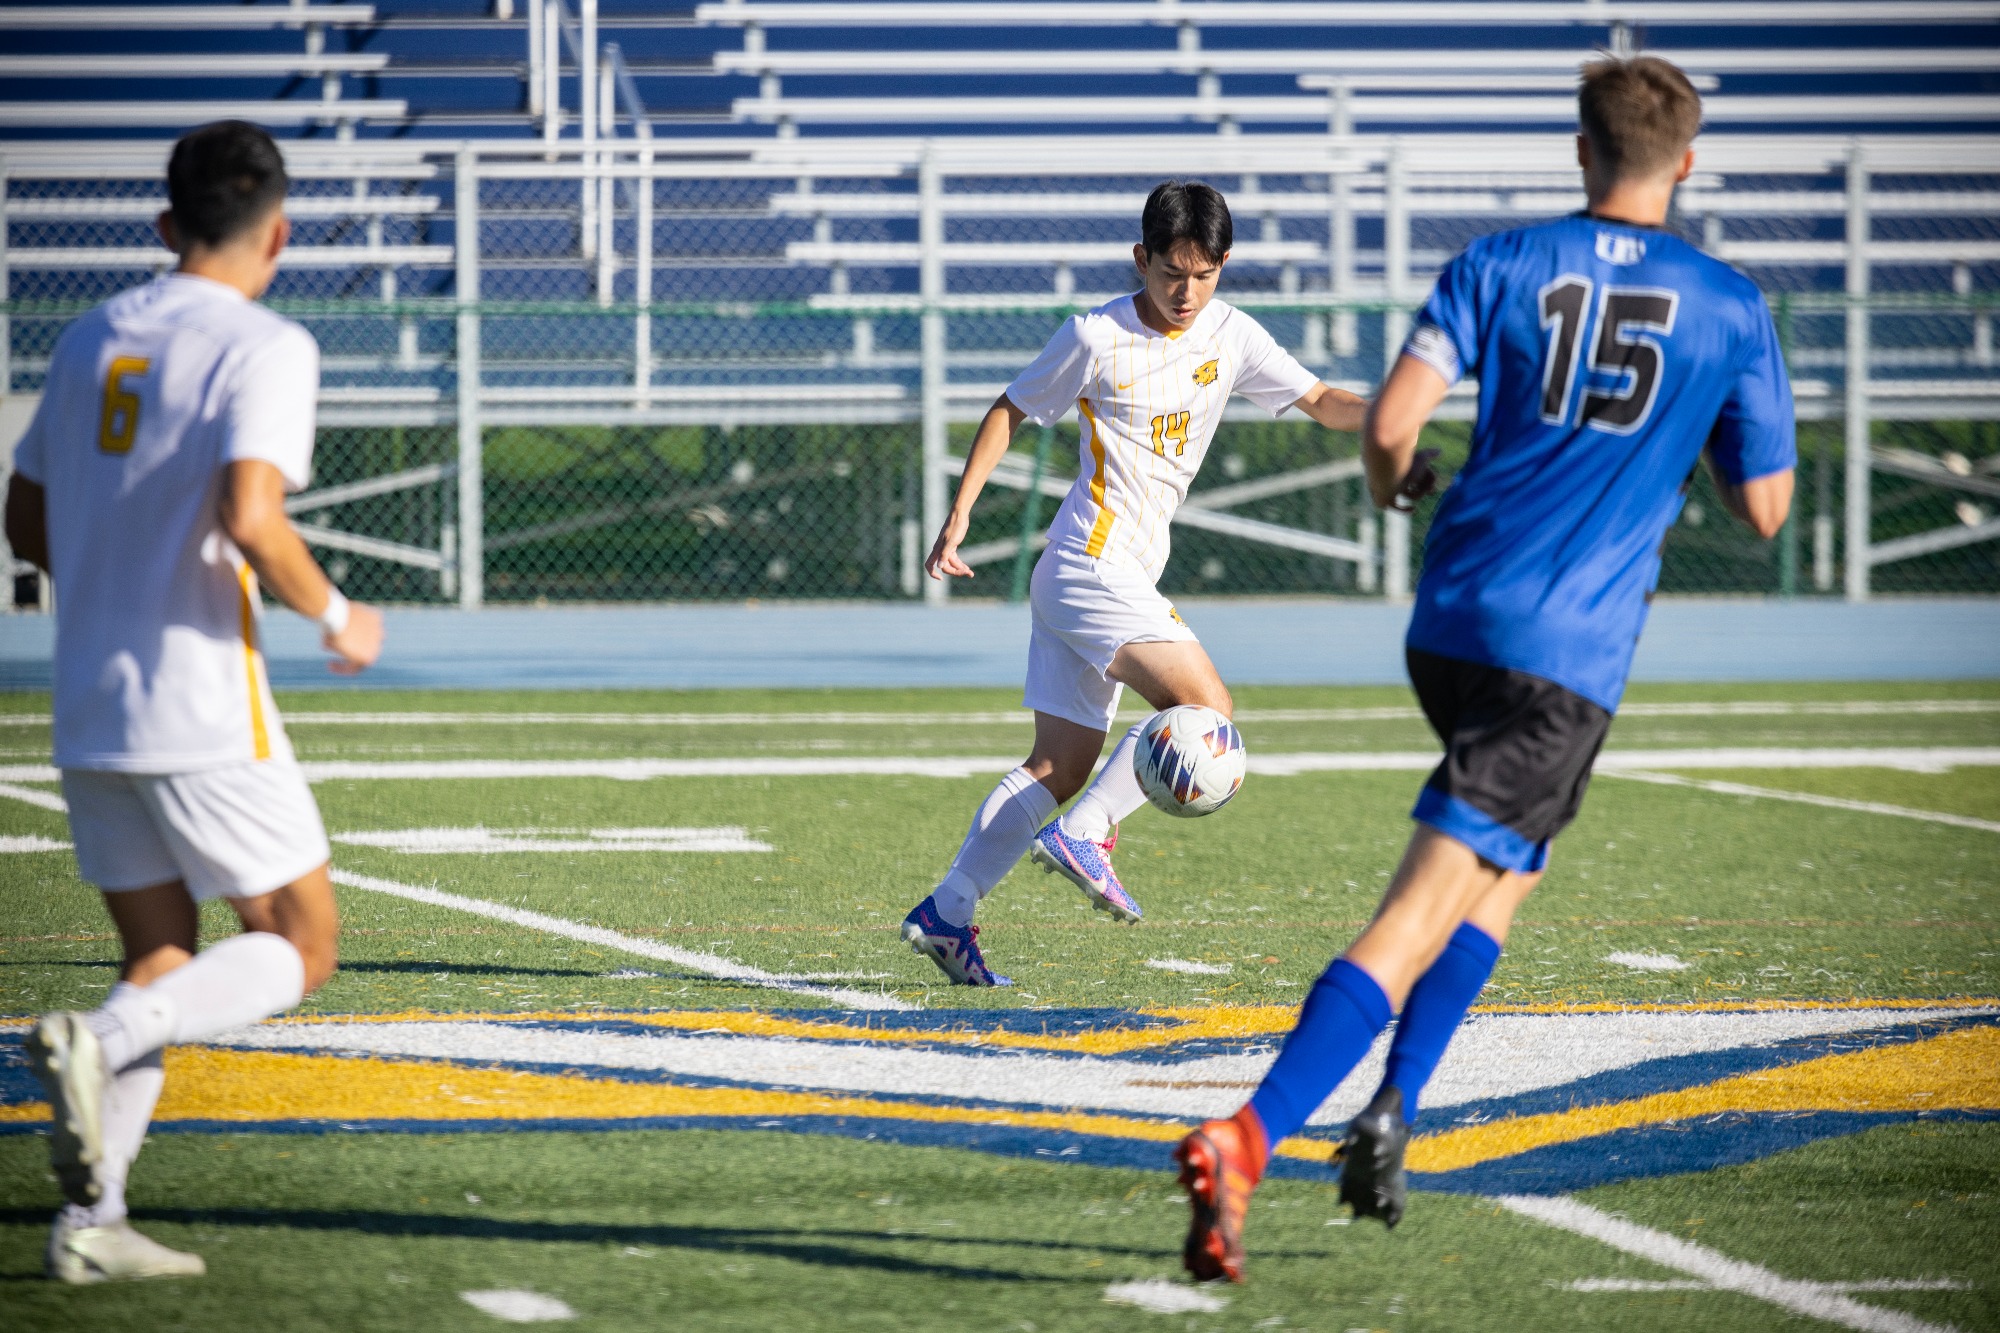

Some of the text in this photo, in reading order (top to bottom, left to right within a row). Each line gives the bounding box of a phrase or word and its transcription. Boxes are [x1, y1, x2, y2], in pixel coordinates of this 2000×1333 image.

[1538, 273, 1680, 436] 15
[98, 355, 152, 456] 6
[1151, 410, 1190, 457] 14
